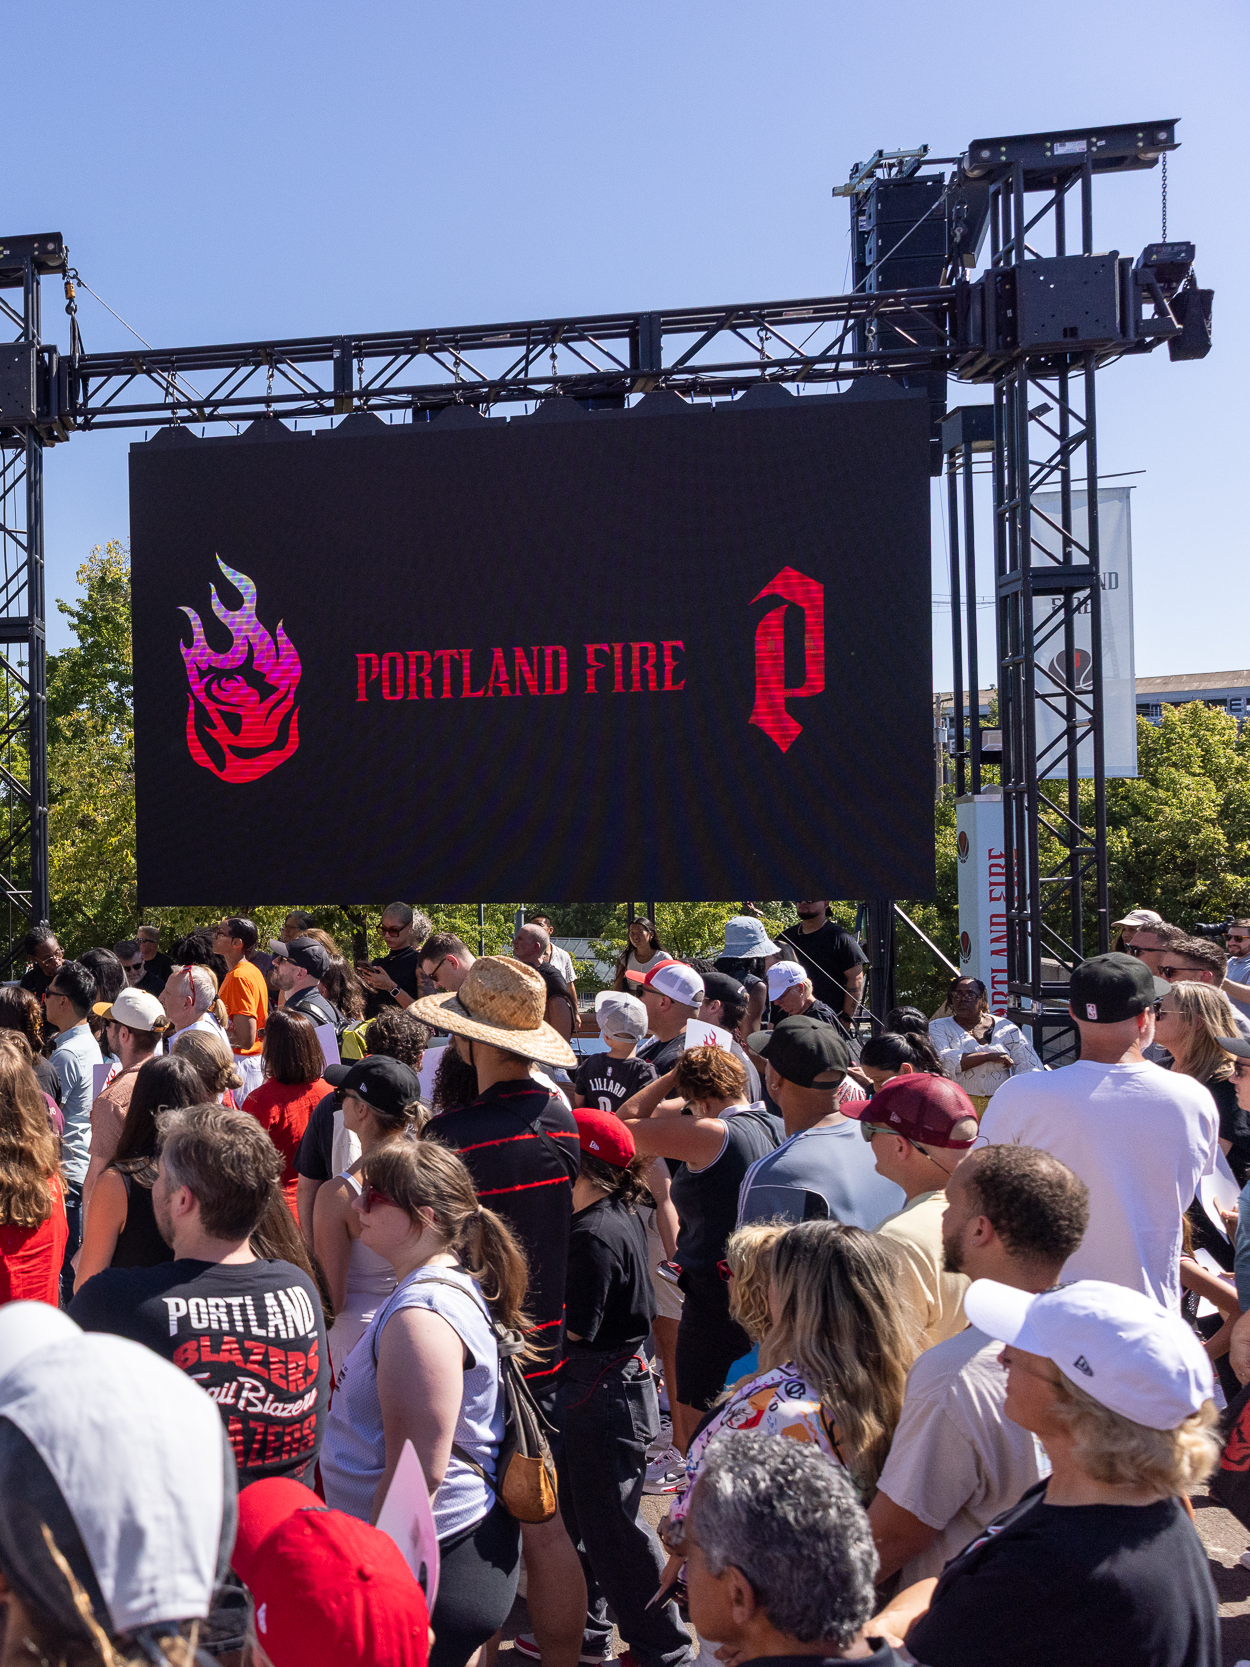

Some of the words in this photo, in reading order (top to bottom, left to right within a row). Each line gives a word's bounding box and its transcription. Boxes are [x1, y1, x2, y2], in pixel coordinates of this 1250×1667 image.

[355, 645, 568, 702] PORTLAND
[584, 640, 686, 693] FIRE
[589, 1077, 626, 1098] LILLARD
[162, 1286, 315, 1339] PORTLAND
[173, 1336, 320, 1393] BLAZERS
[237, 1377, 318, 1417] Blazers
[228, 1414, 317, 1468] AZERS
